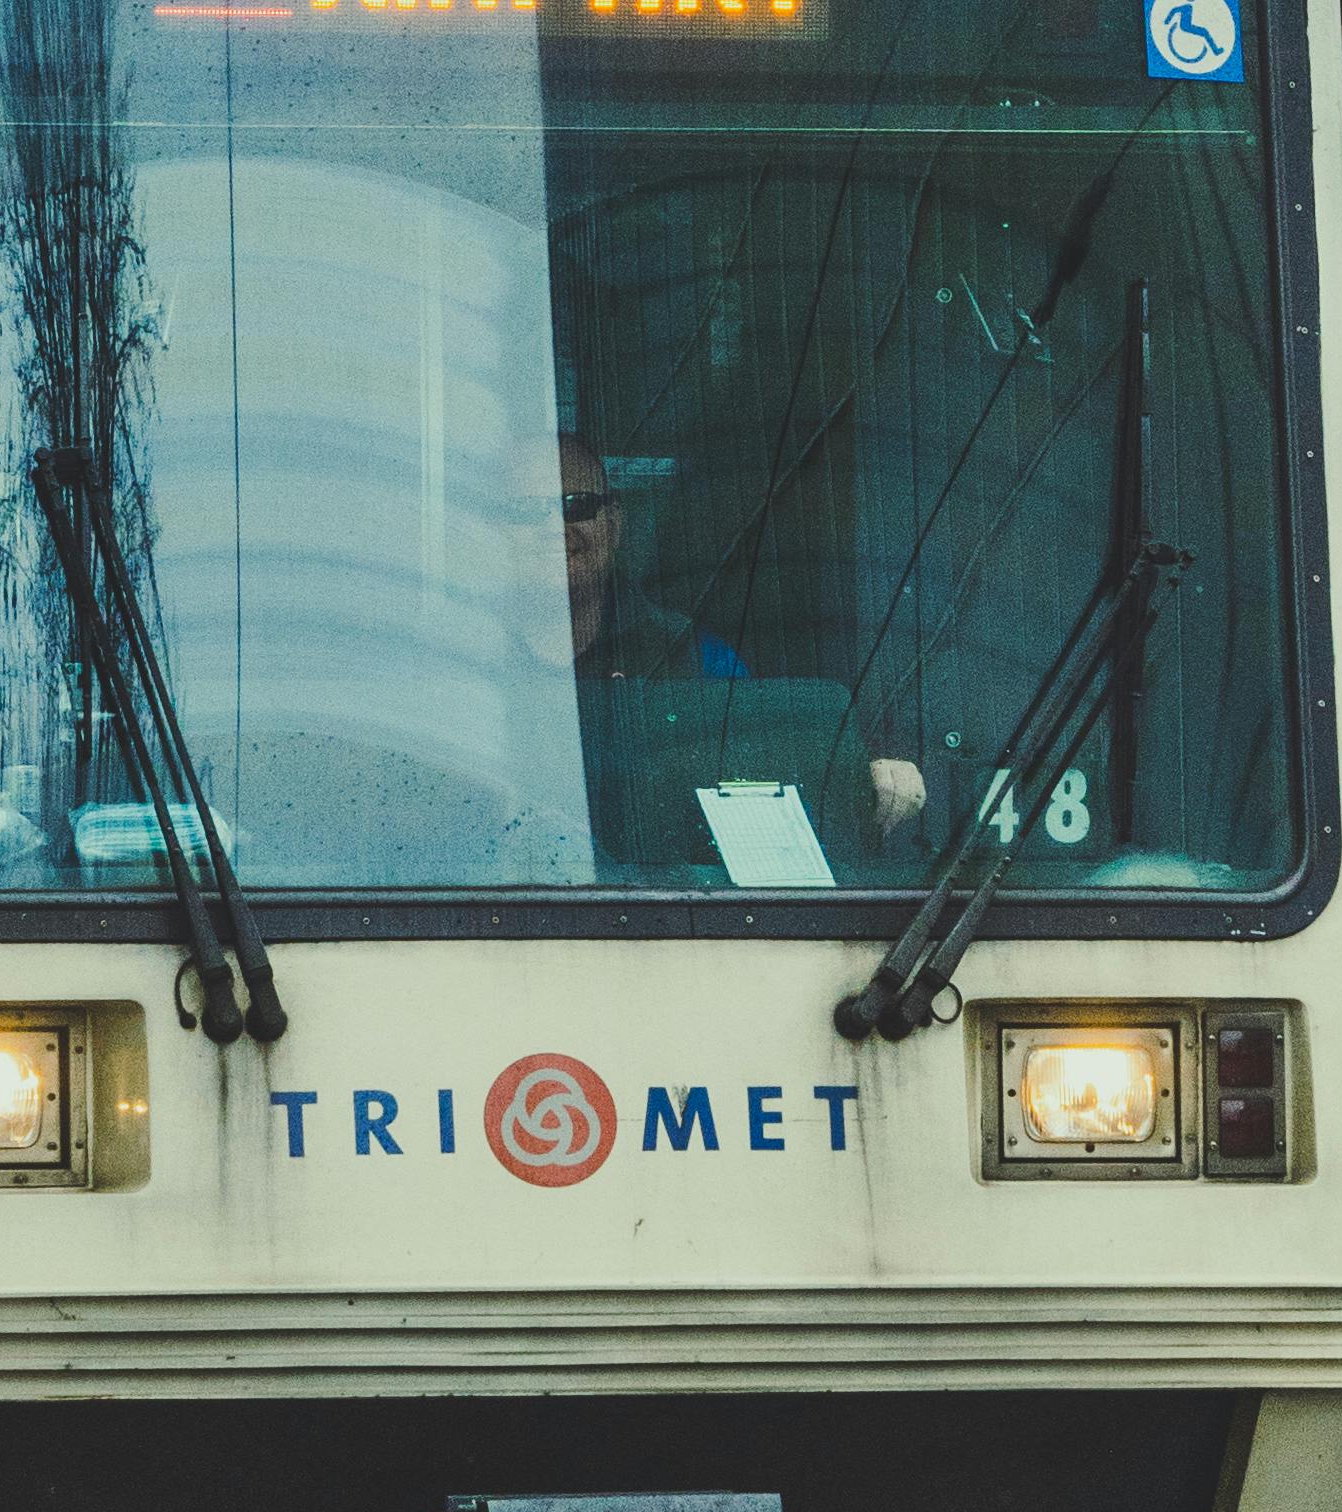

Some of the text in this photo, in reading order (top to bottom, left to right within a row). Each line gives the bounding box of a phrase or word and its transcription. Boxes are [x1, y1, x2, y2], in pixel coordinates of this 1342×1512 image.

[978, 768, 1091, 844] 48
[270, 1085, 859, 1158] TRI MET
